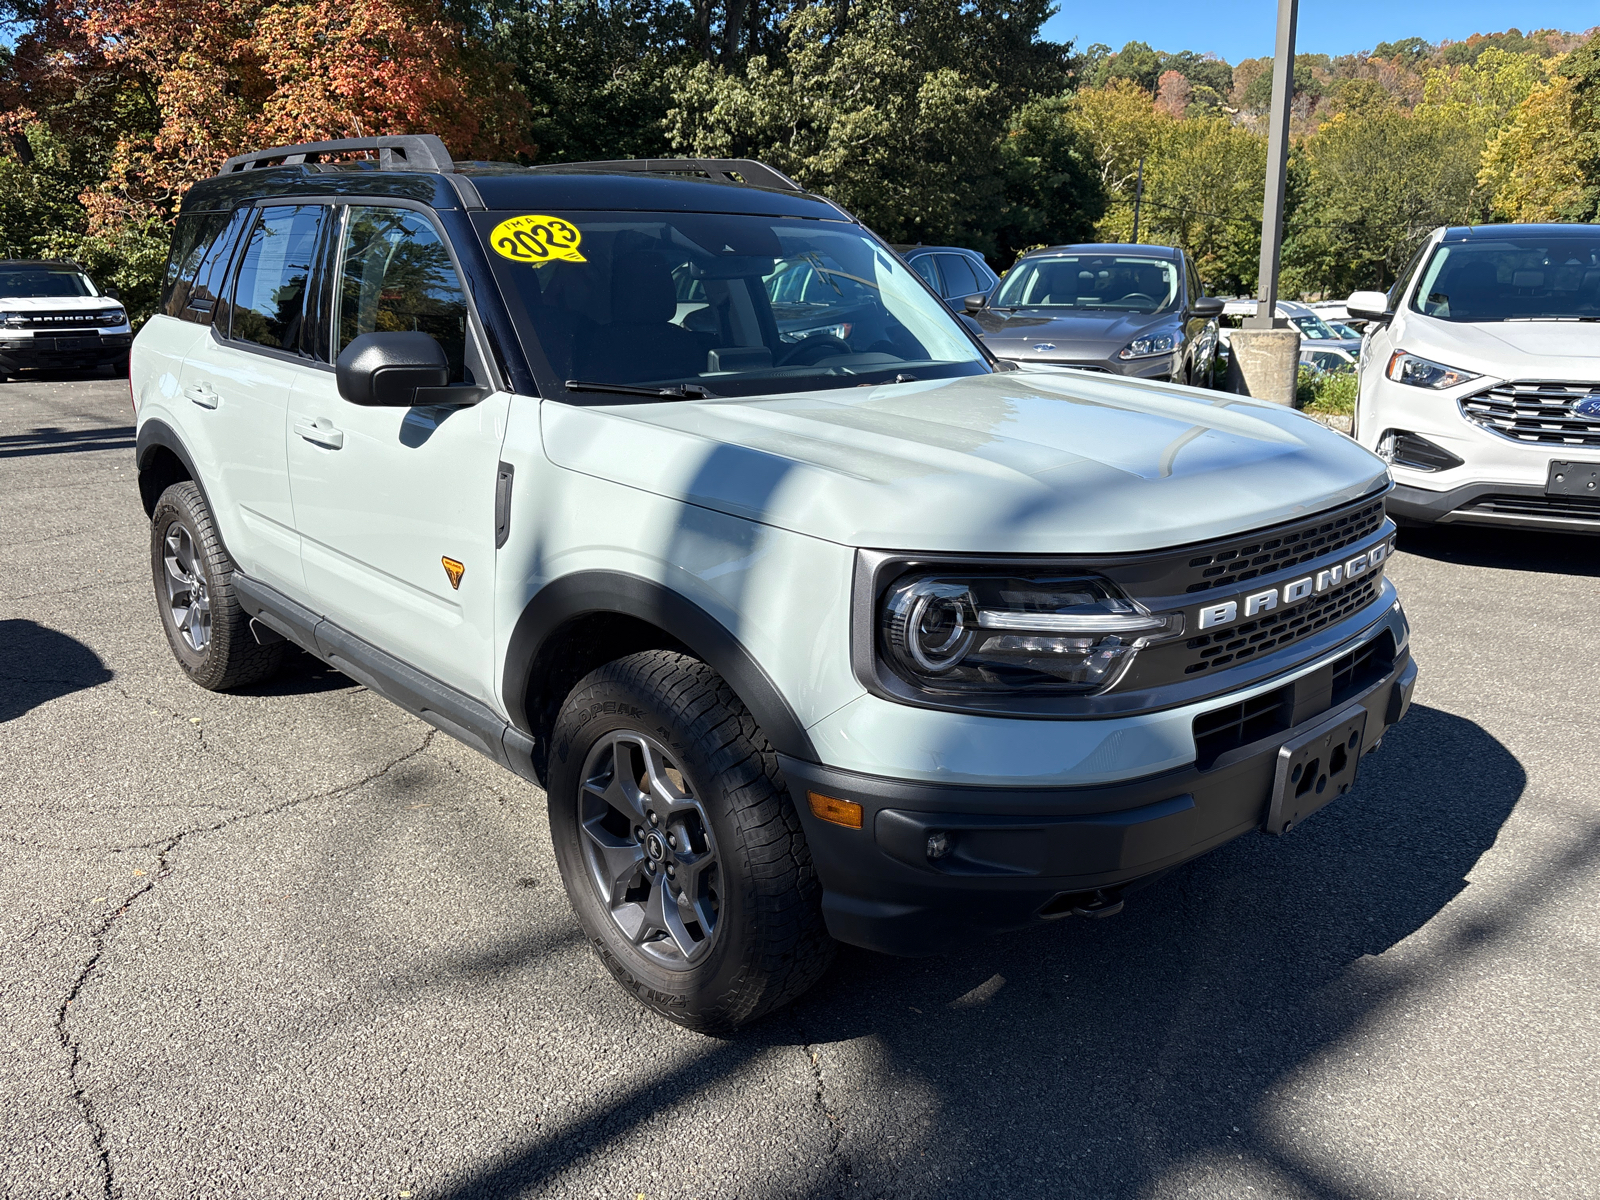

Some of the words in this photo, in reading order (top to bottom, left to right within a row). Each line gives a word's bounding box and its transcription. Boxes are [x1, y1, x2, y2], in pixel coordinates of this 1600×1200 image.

[498, 221, 577, 258] 2023
[504, 220, 523, 231] I'M
[525, 217, 536, 225] A
[1199, 543, 1386, 629] BRONCO
